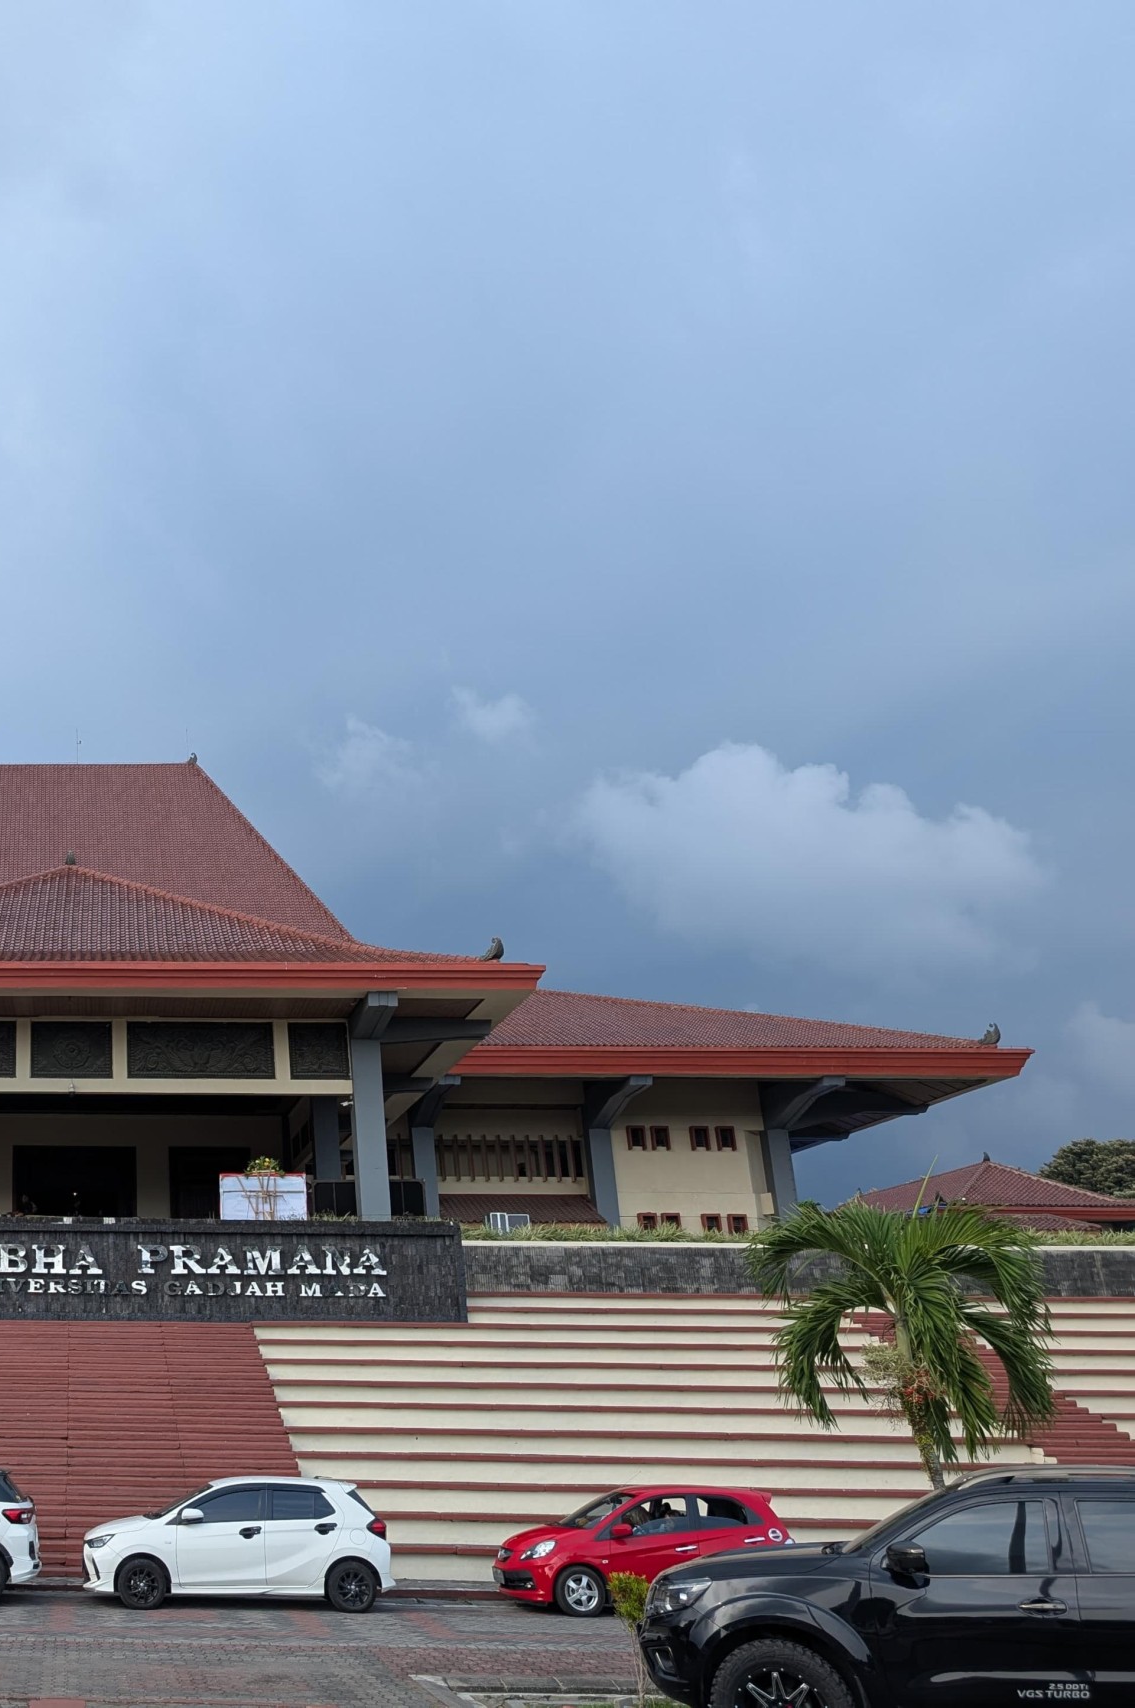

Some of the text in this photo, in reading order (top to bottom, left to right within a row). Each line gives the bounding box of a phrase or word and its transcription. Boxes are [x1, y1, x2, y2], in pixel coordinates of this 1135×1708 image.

[137, 1244, 388, 1276] PRAMANA
[165, 1280, 286, 1297] GADJAH
[299, 1281, 387, 1298] MADA
[1017, 1690, 1090, 1699] VGS TURBO
